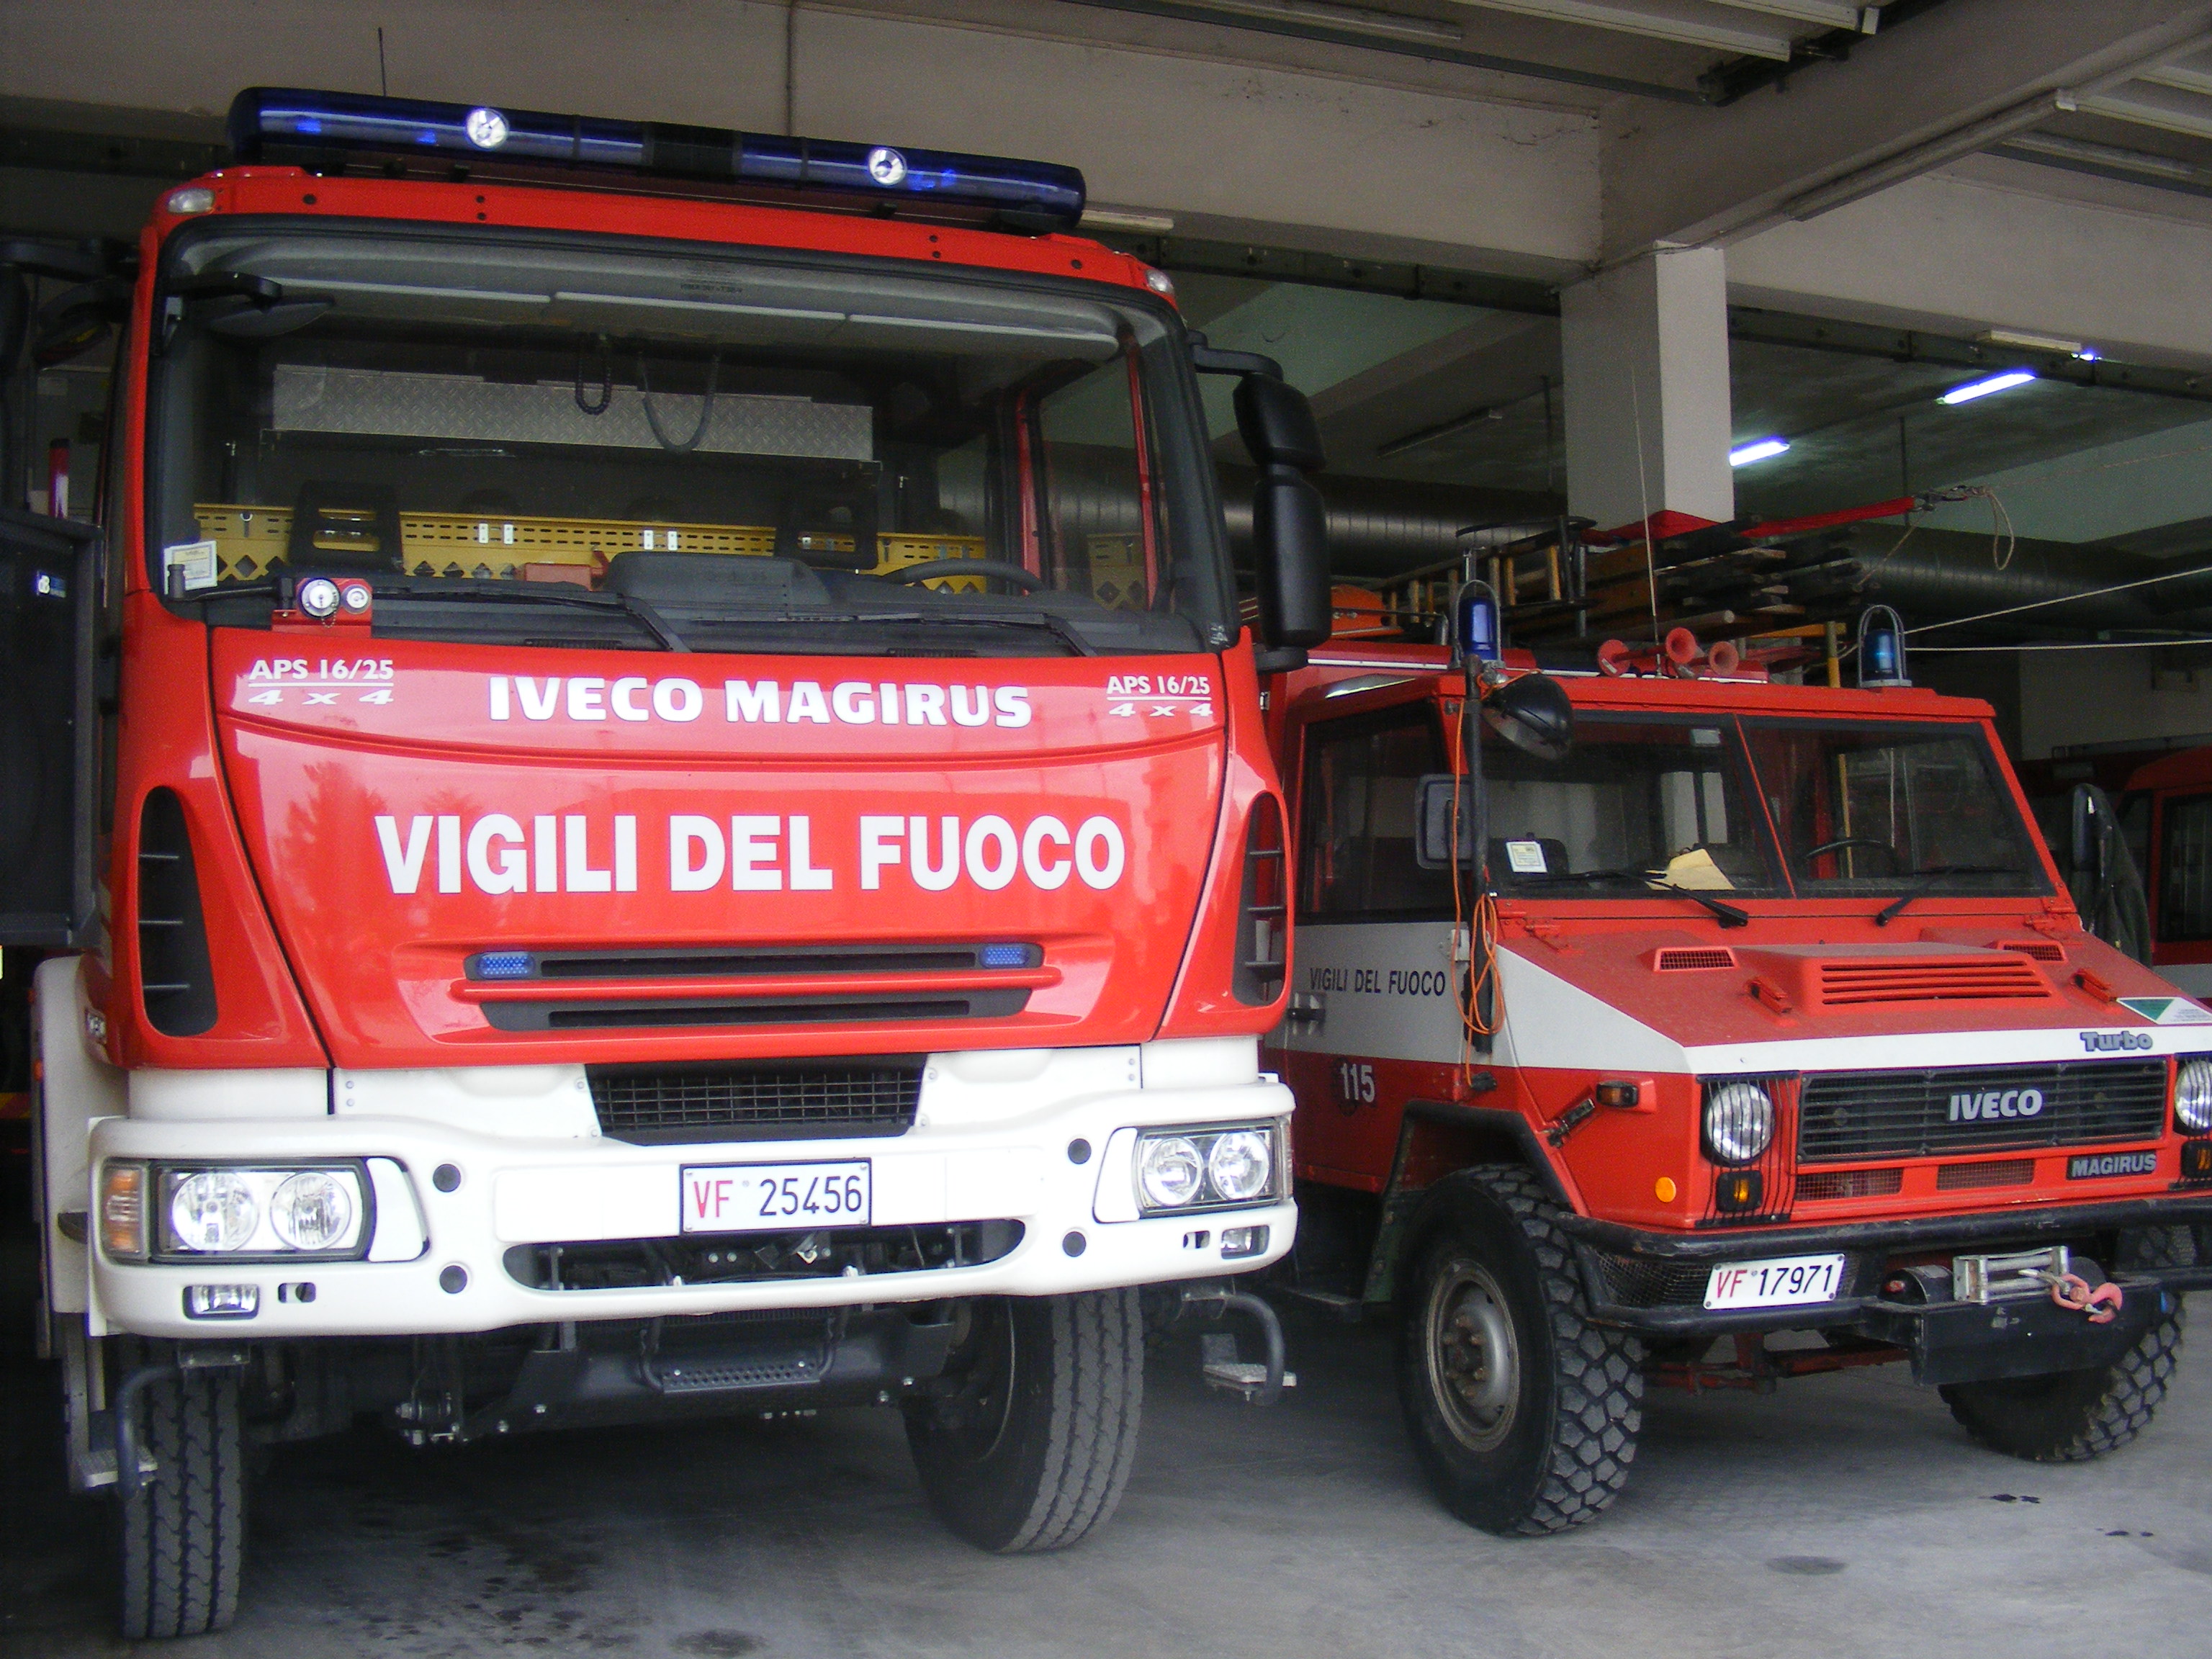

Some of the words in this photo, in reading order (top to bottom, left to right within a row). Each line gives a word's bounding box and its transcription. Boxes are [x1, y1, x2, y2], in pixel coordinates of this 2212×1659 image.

[248, 659, 309, 680] APS
[320, 659, 395, 680] 16/25
[248, 689, 284, 706] 4
[359, 689, 394, 705] 4
[1106, 675, 1151, 695] APS
[1157, 675, 1210, 695] 16/25
[489, 676, 704, 721] IVECO
[724, 680, 1033, 728] MAGIRUS
[1108, 703, 1136, 717] 4
[1189, 703, 1213, 717] 4
[374, 814, 637, 894] VIGILI
[669, 814, 833, 892] DEL
[860, 814, 1126, 892] FUOCO
[1310, 967, 1348, 992] VIGILI
[1354, 968, 1381, 994] DEL
[1388, 970, 1446, 997] FUOCO
[2080, 1030, 2154, 1051] Turbo
[1340, 1062, 1375, 1103] 115
[1949, 1089, 2044, 1122] IVECO
[2072, 1153, 2158, 1178] MAGIRUS
[693, 1179, 734, 1219] VF
[759, 1174, 863, 1217] 25456
[1717, 1269, 1748, 1299] VF
[1758, 1264, 1833, 1297] 17971
